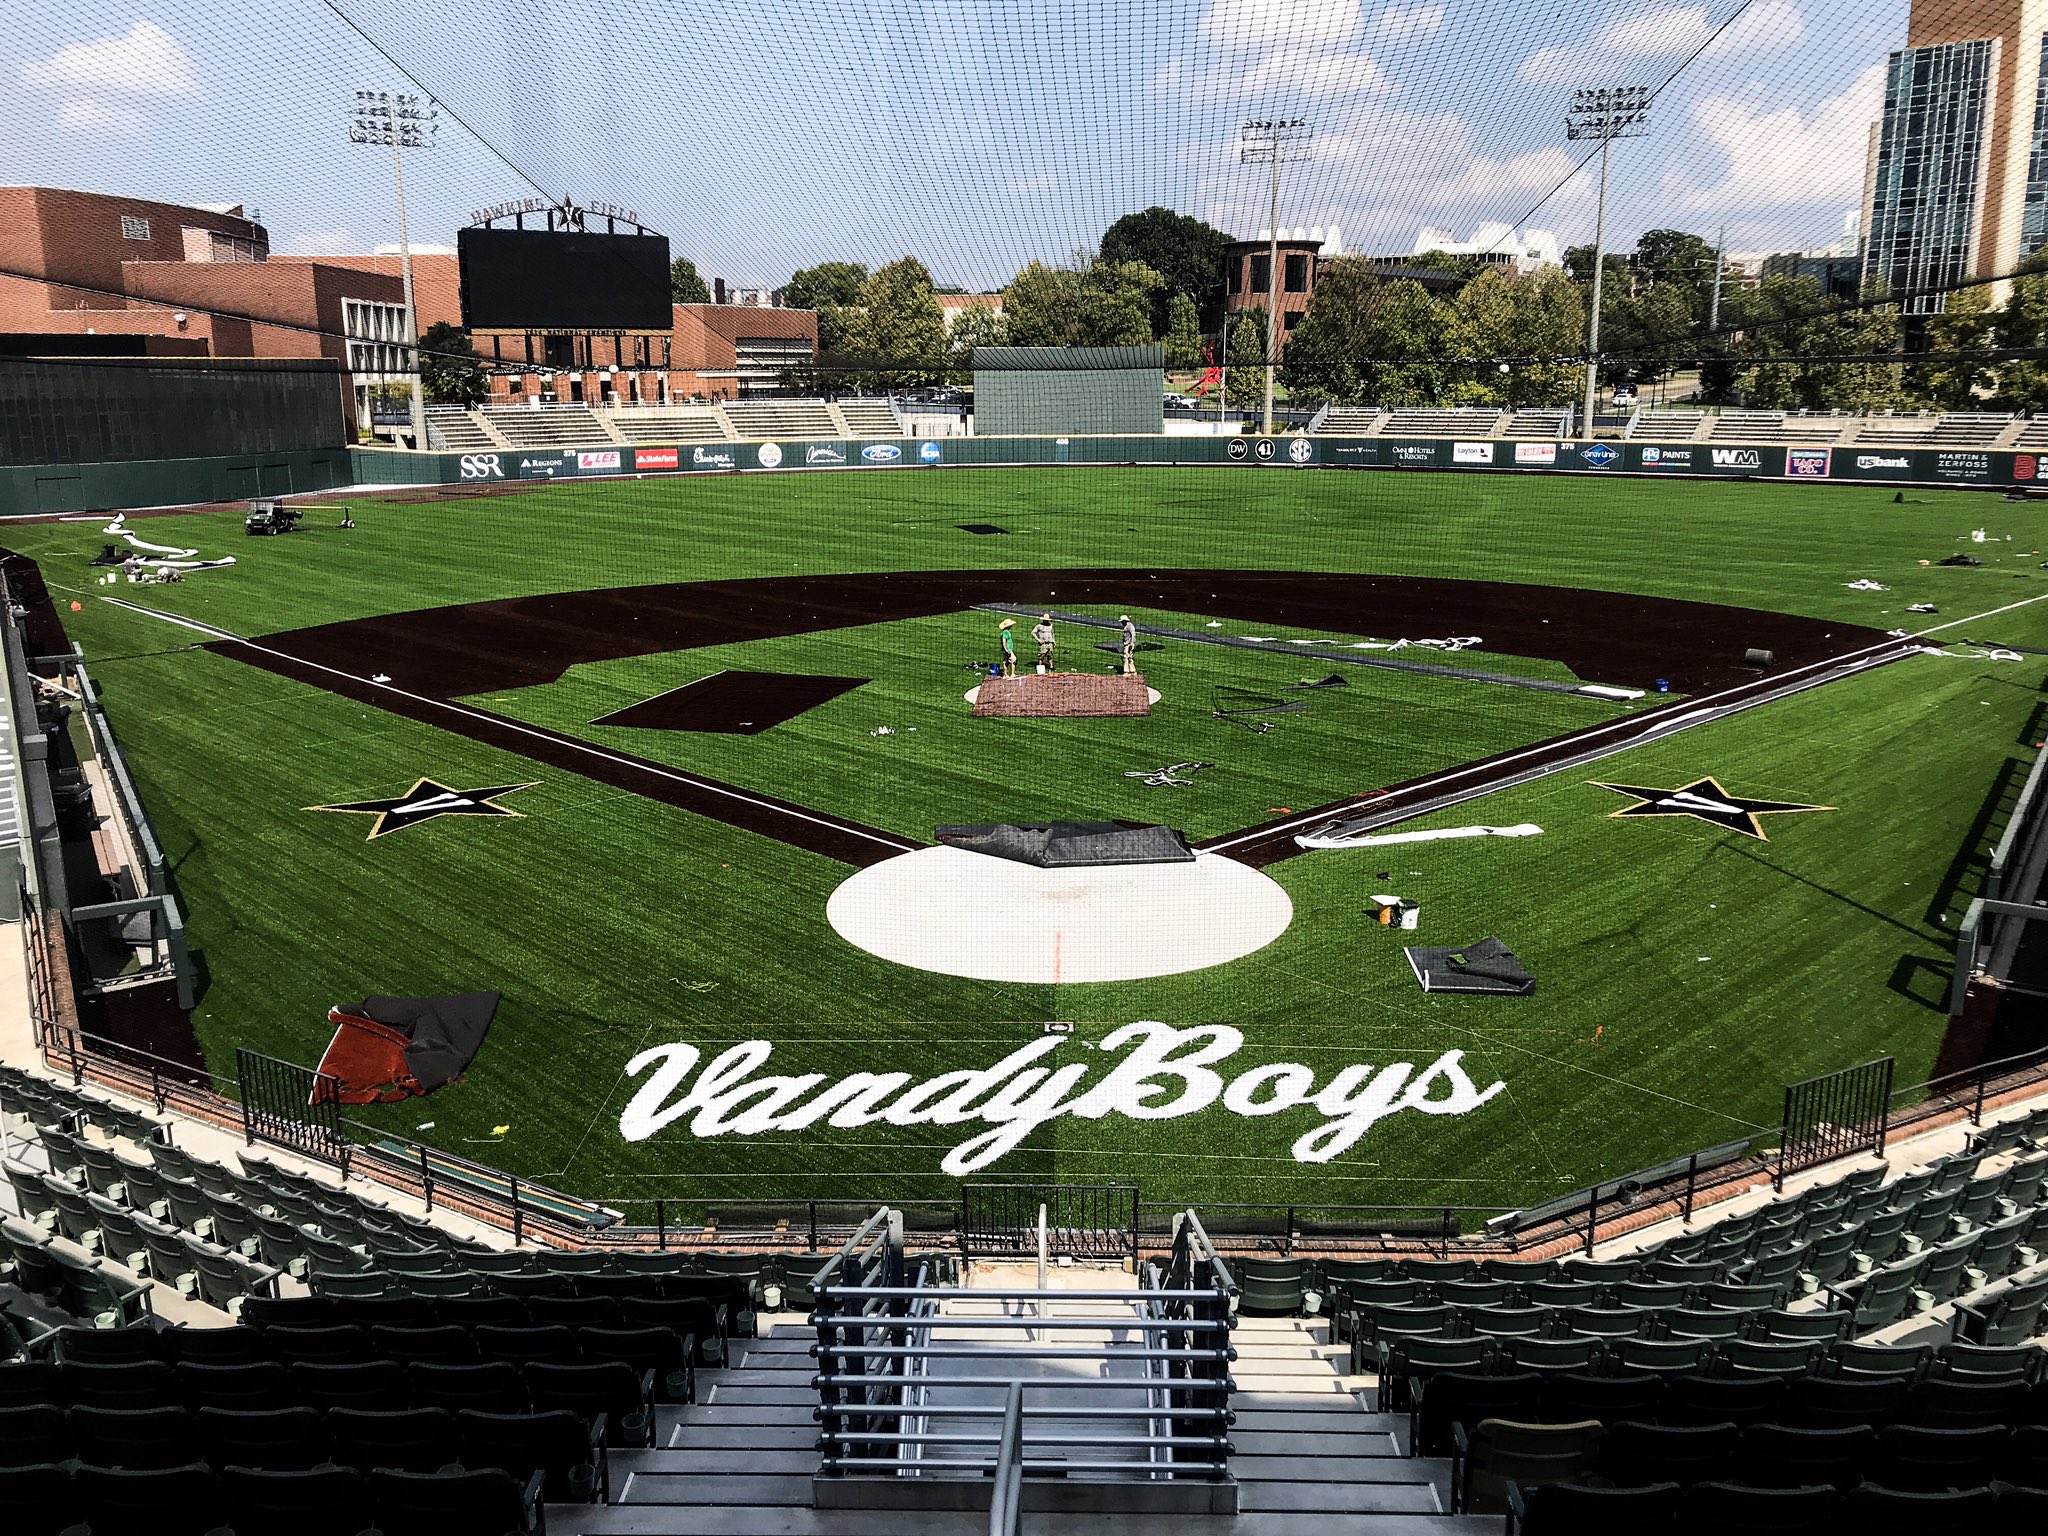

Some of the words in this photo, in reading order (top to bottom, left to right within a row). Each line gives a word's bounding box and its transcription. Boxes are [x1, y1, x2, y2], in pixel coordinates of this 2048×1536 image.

[590, 200, 638, 223] FIELD
[1230, 444, 1246, 454] DW
[1258, 443, 1272, 456] 41
[1291, 440, 1311, 458] SEC
[1413, 446, 1435, 454] HOTELS
[1560, 442, 1575, 450] 375
[563, 449, 577, 457] 375
[869, 446, 894, 459] Ford
[1457, 447, 1478, 455] Layton
[1662, 451, 1691, 459] PAINTS
[595, 453, 618, 463] LEE
[1711, 449, 1762, 465] WM
[460, 454, 505, 478] SSR
[1792, 458, 1824, 467] TACO
[1937, 460, 1988, 468] ZERFOSS
[1797, 465, 1818, 474] CO.
